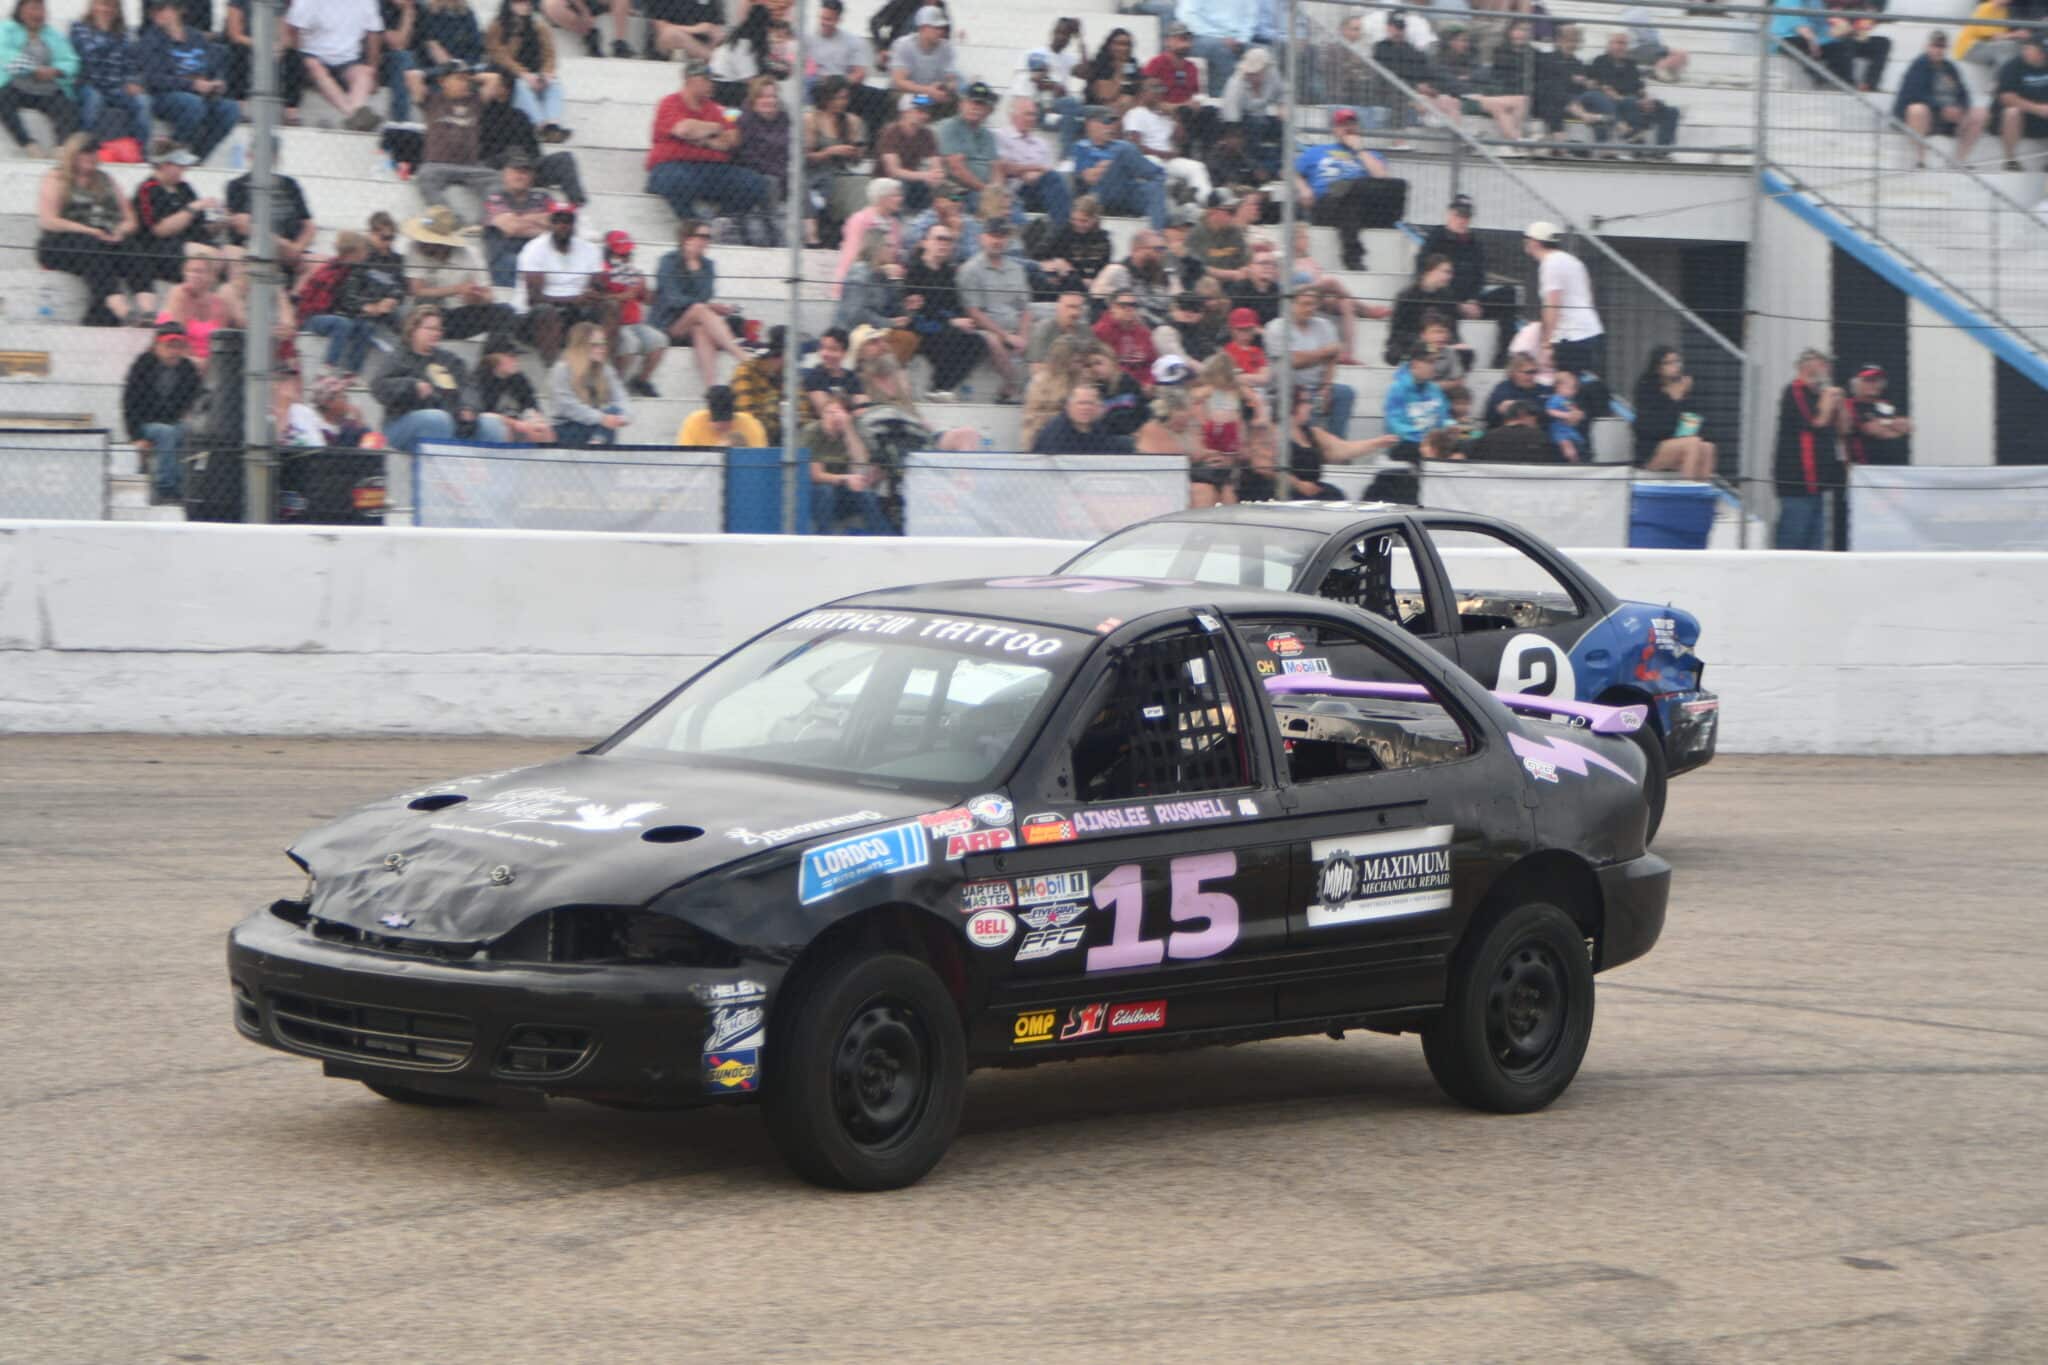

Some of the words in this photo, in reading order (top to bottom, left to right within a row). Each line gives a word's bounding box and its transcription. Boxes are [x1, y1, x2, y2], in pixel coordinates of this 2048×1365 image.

[919, 618, 1063, 657] TATTOO
[1073, 806, 1151, 832] AINSLEE
[1153, 799, 1231, 823] RUSNELL
[812, 838, 889, 877] LORDCO
[947, 829, 1012, 858] ARP
[1364, 852, 1450, 881] MAXIMUM
[1018, 874, 1065, 898] Mobil
[1070, 873, 1083, 892] 1
[1361, 876, 1417, 895] MECHANICAL
[1419, 873, 1450, 888] REPAIR
[1086, 851, 1239, 971] 15
[974, 918, 1009, 935] BELL
[1014, 1014, 1055, 1037] OMP
[1111, 1007, 1161, 1026] Edelbrock
